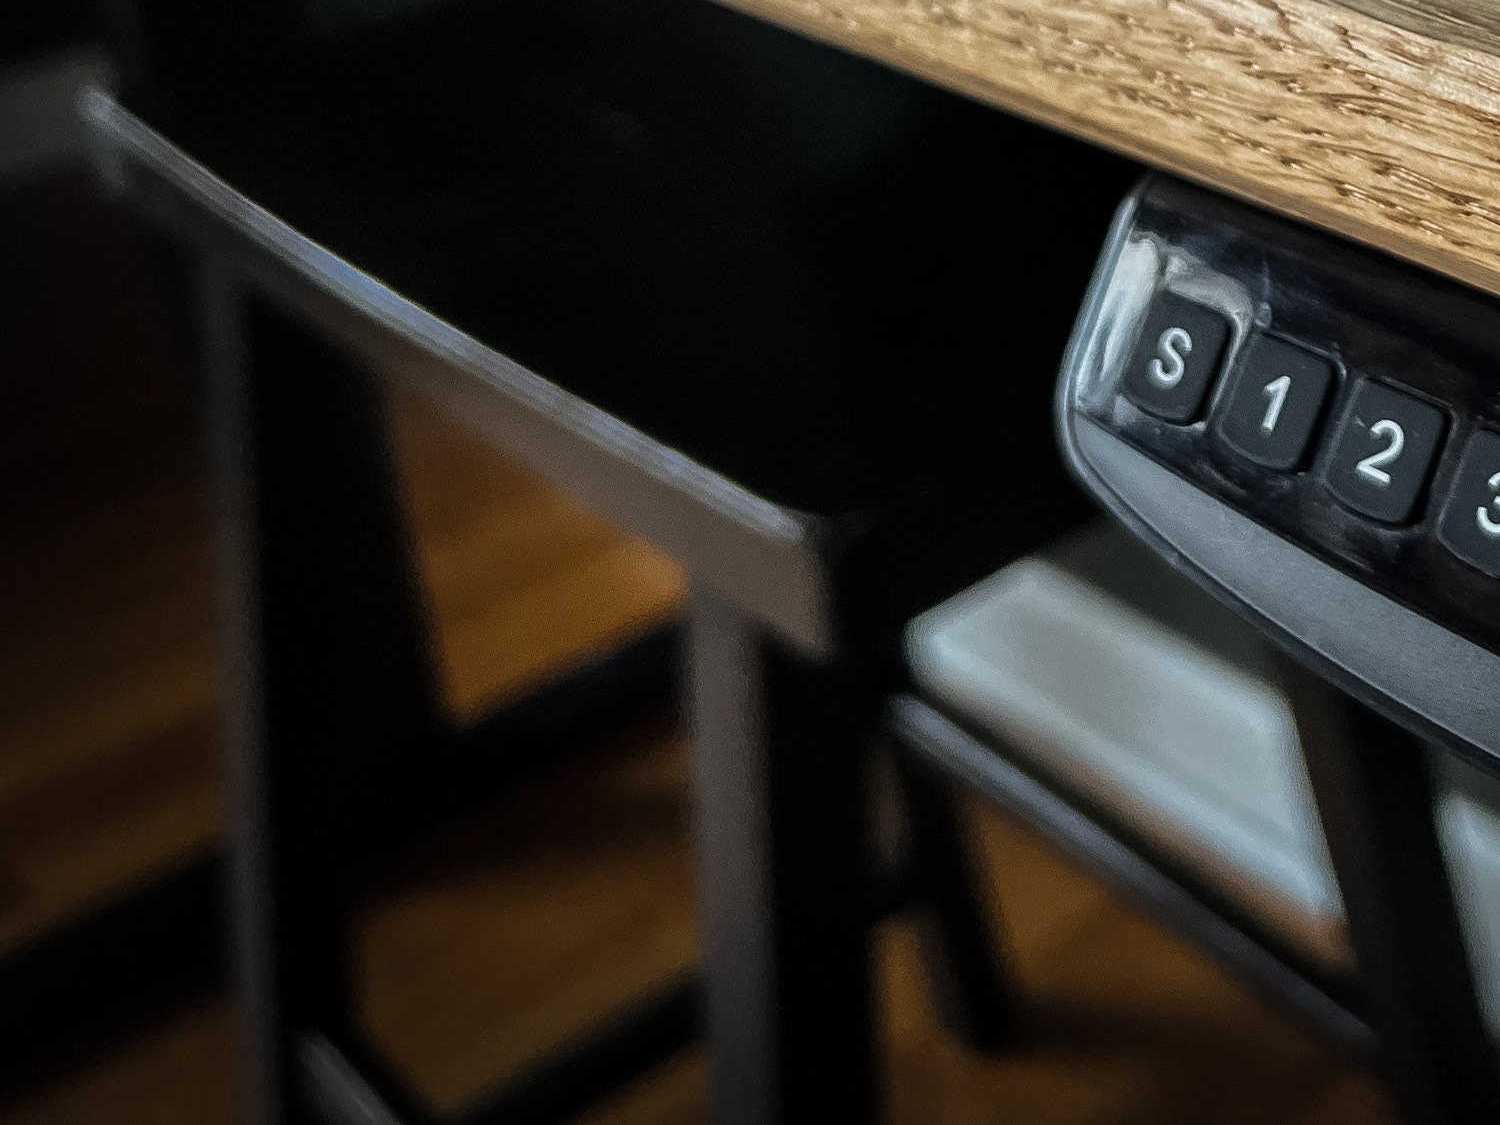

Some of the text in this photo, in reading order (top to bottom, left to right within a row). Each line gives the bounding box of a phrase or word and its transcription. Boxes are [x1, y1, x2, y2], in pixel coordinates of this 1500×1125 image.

[1147, 327, 1192, 389] S
[1262, 375, 1292, 435] 1
[1354, 418, 1405, 485] 2
